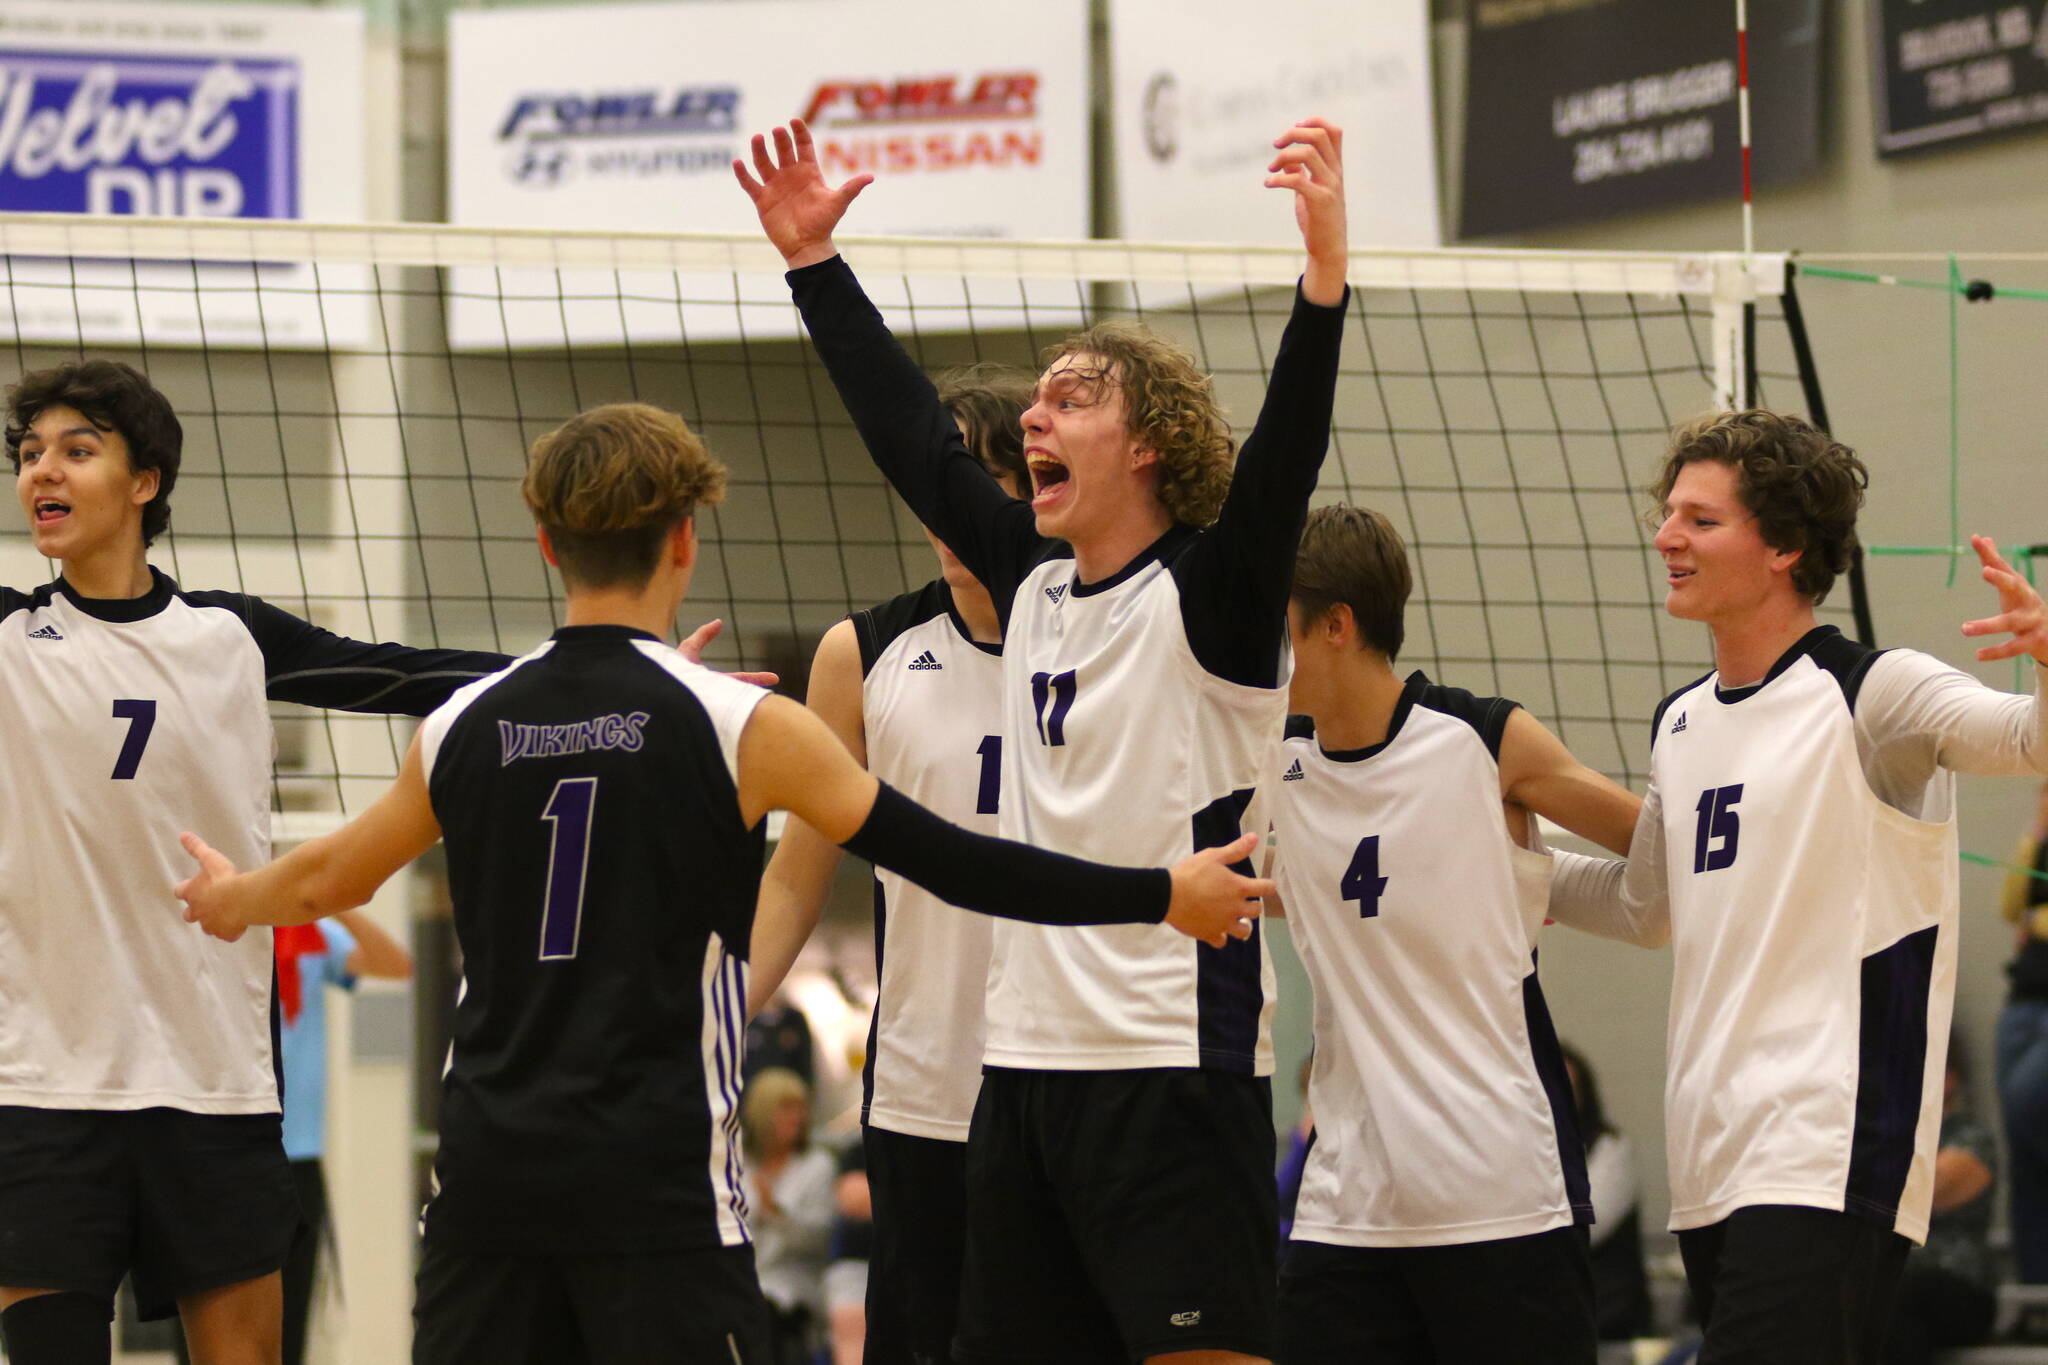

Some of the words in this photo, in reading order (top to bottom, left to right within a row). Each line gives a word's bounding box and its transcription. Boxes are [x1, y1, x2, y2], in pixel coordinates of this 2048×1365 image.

[495, 87, 741, 139] FOWLER
[801, 70, 1038, 128] FOWLER
[822, 131, 1041, 172] NISSAN
[87, 166, 244, 217] DIP
[1045, 587, 1060, 604] adida
[28, 632, 64, 641] adidas
[908, 661, 943, 671] adidas
[1031, 669, 1077, 746] 11
[111, 699, 157, 780] 7
[498, 711, 651, 767] VIKINGS
[976, 735, 1003, 815] 1
[1694, 783, 1745, 874] 15
[538, 776, 598, 961] 1
[1340, 835, 1389, 919] 4
